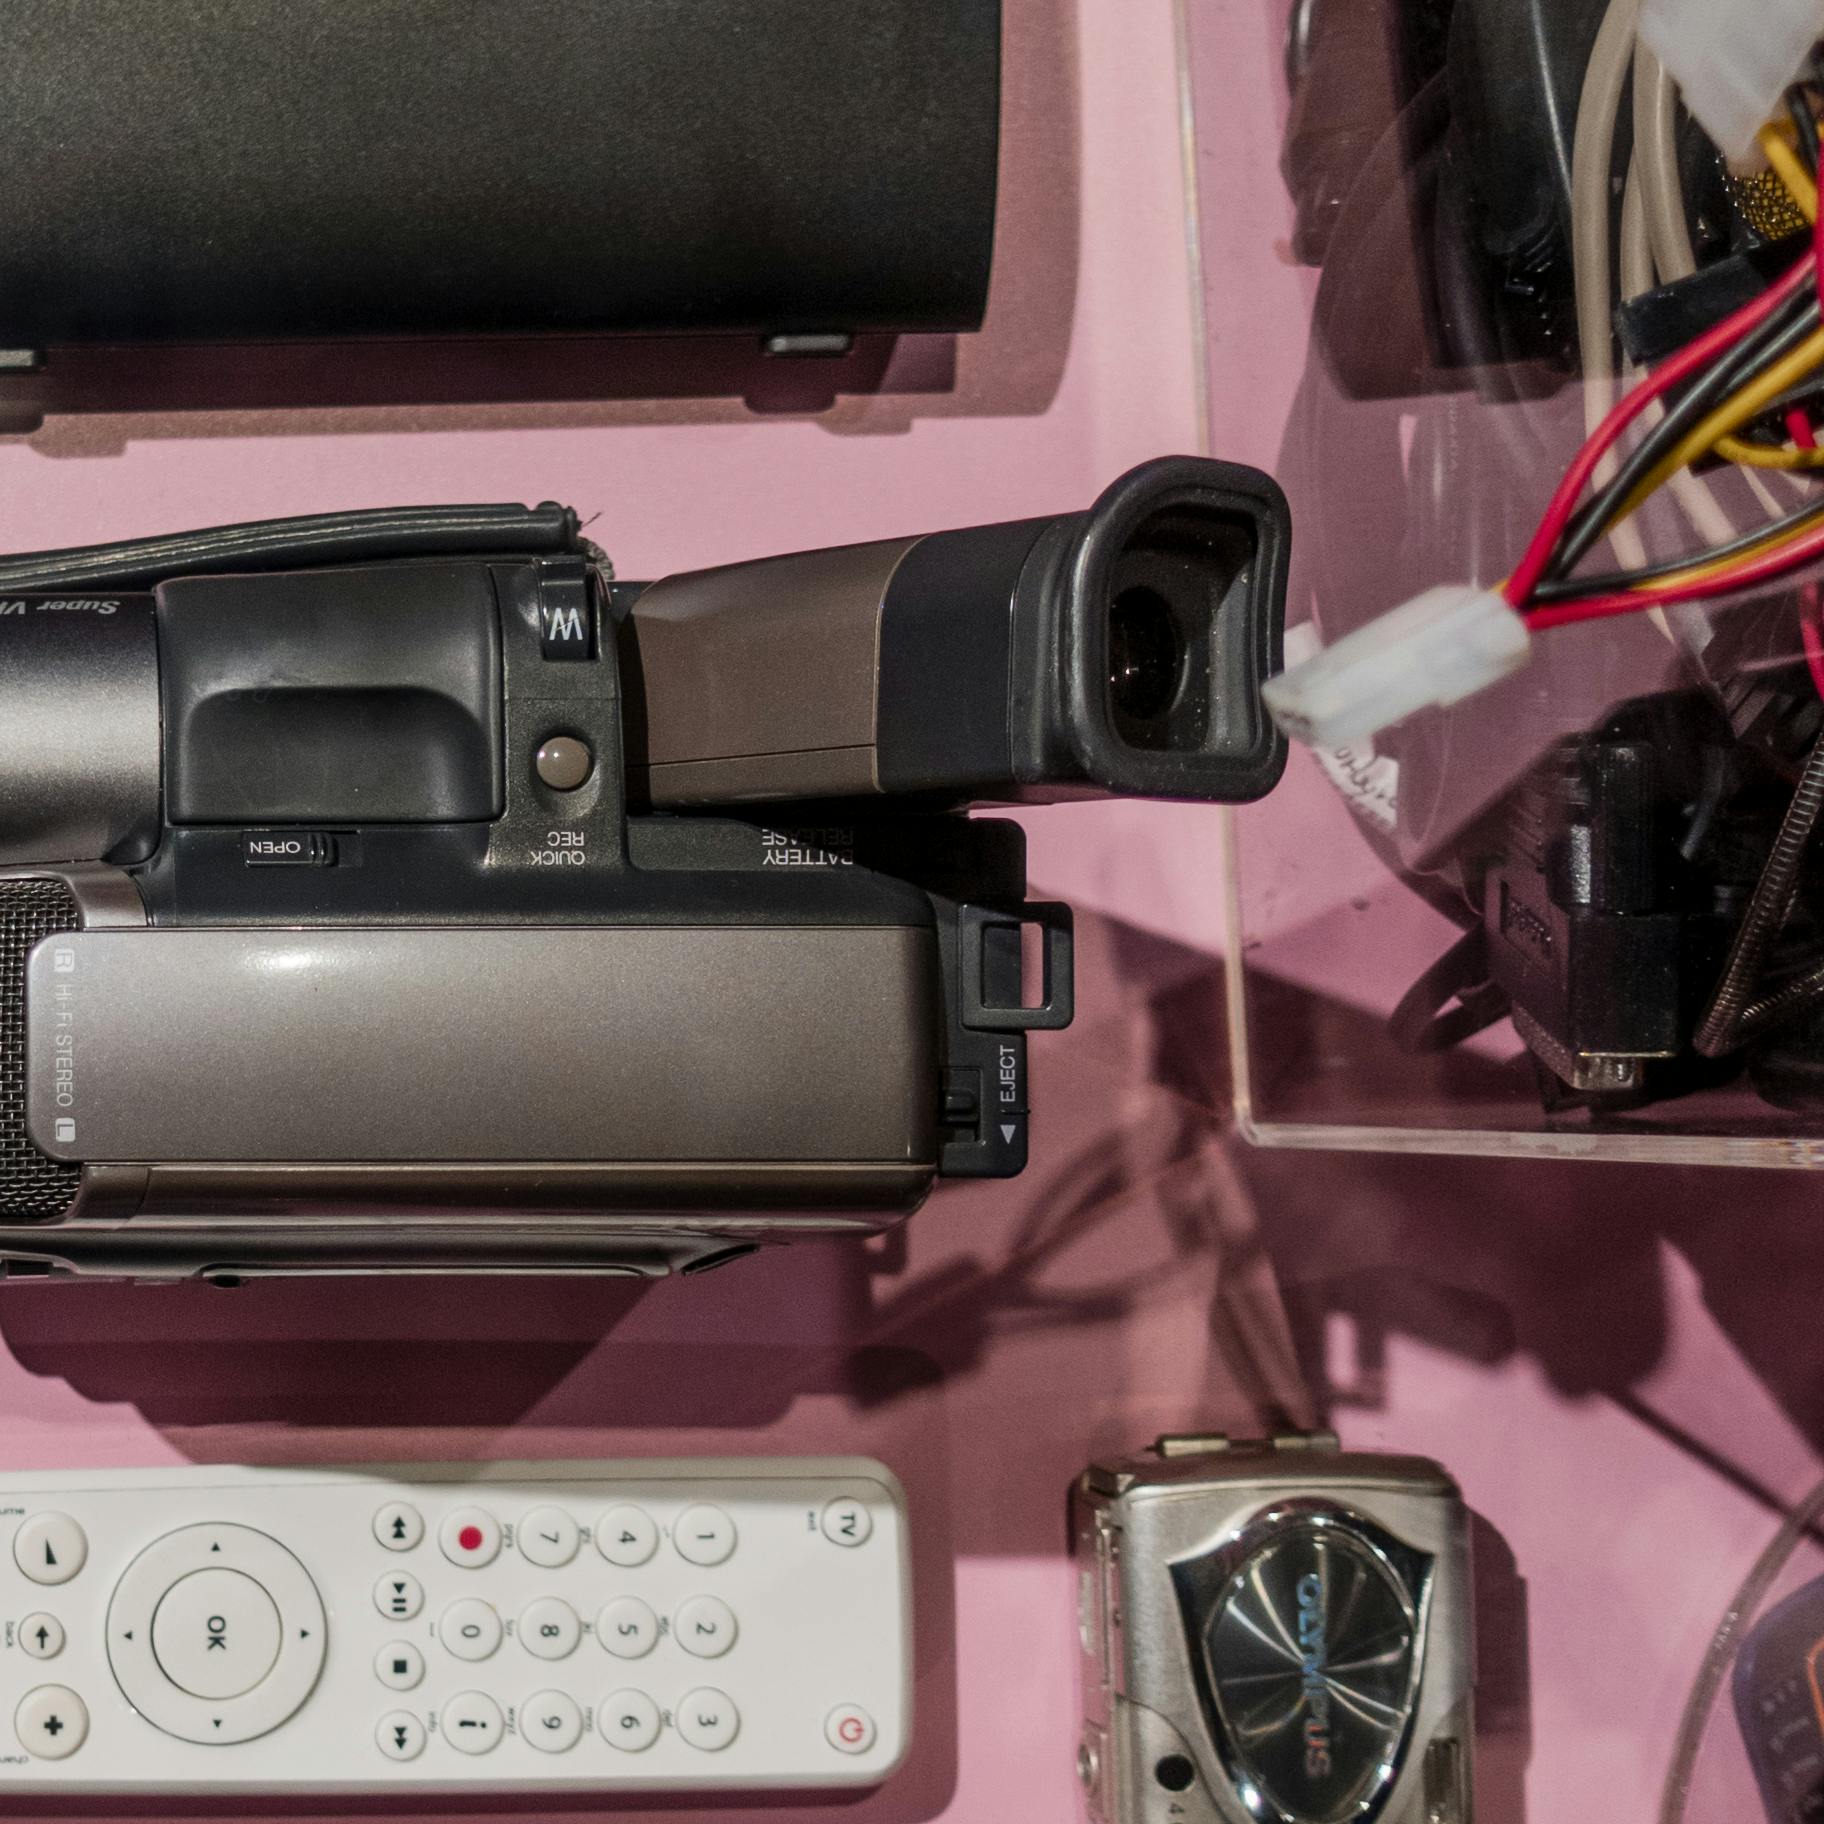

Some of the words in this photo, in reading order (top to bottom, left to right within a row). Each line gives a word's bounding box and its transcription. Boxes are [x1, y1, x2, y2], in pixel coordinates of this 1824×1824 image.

[36, 599, 120, 615] Super
[548, 606, 584, 641] W
[547, 830, 585, 846] REC
[249, 841, 301, 854] OPEN
[530, 849, 585, 866] QUICK
[762, 848, 854, 865] BATTERY
[55, 983, 73, 1028] Hi-Fi
[56, 1034, 74, 1107] STEREO
[999, 1044, 1016, 1102] EJECT
[839, 1511, 857, 1538] TV
[539, 1531, 559, 1544] 7
[618, 1530, 637, 1544] 4
[696, 1531, 715, 1541] 1
[6, 1620, 16, 1649] back
[206, 1615, 227, 1651] OK
[460, 1624, 481, 1639] 0
[540, 1623, 560, 1638] 8
[618, 1623, 638, 1636] 5
[695, 1622, 716, 1636] 2
[1296, 1573, 1332, 1780] OLYMPUS
[541, 1715, 562, 1729] 9
[620, 1715, 641, 1729] 6
[697, 1714, 718, 1728] 3
